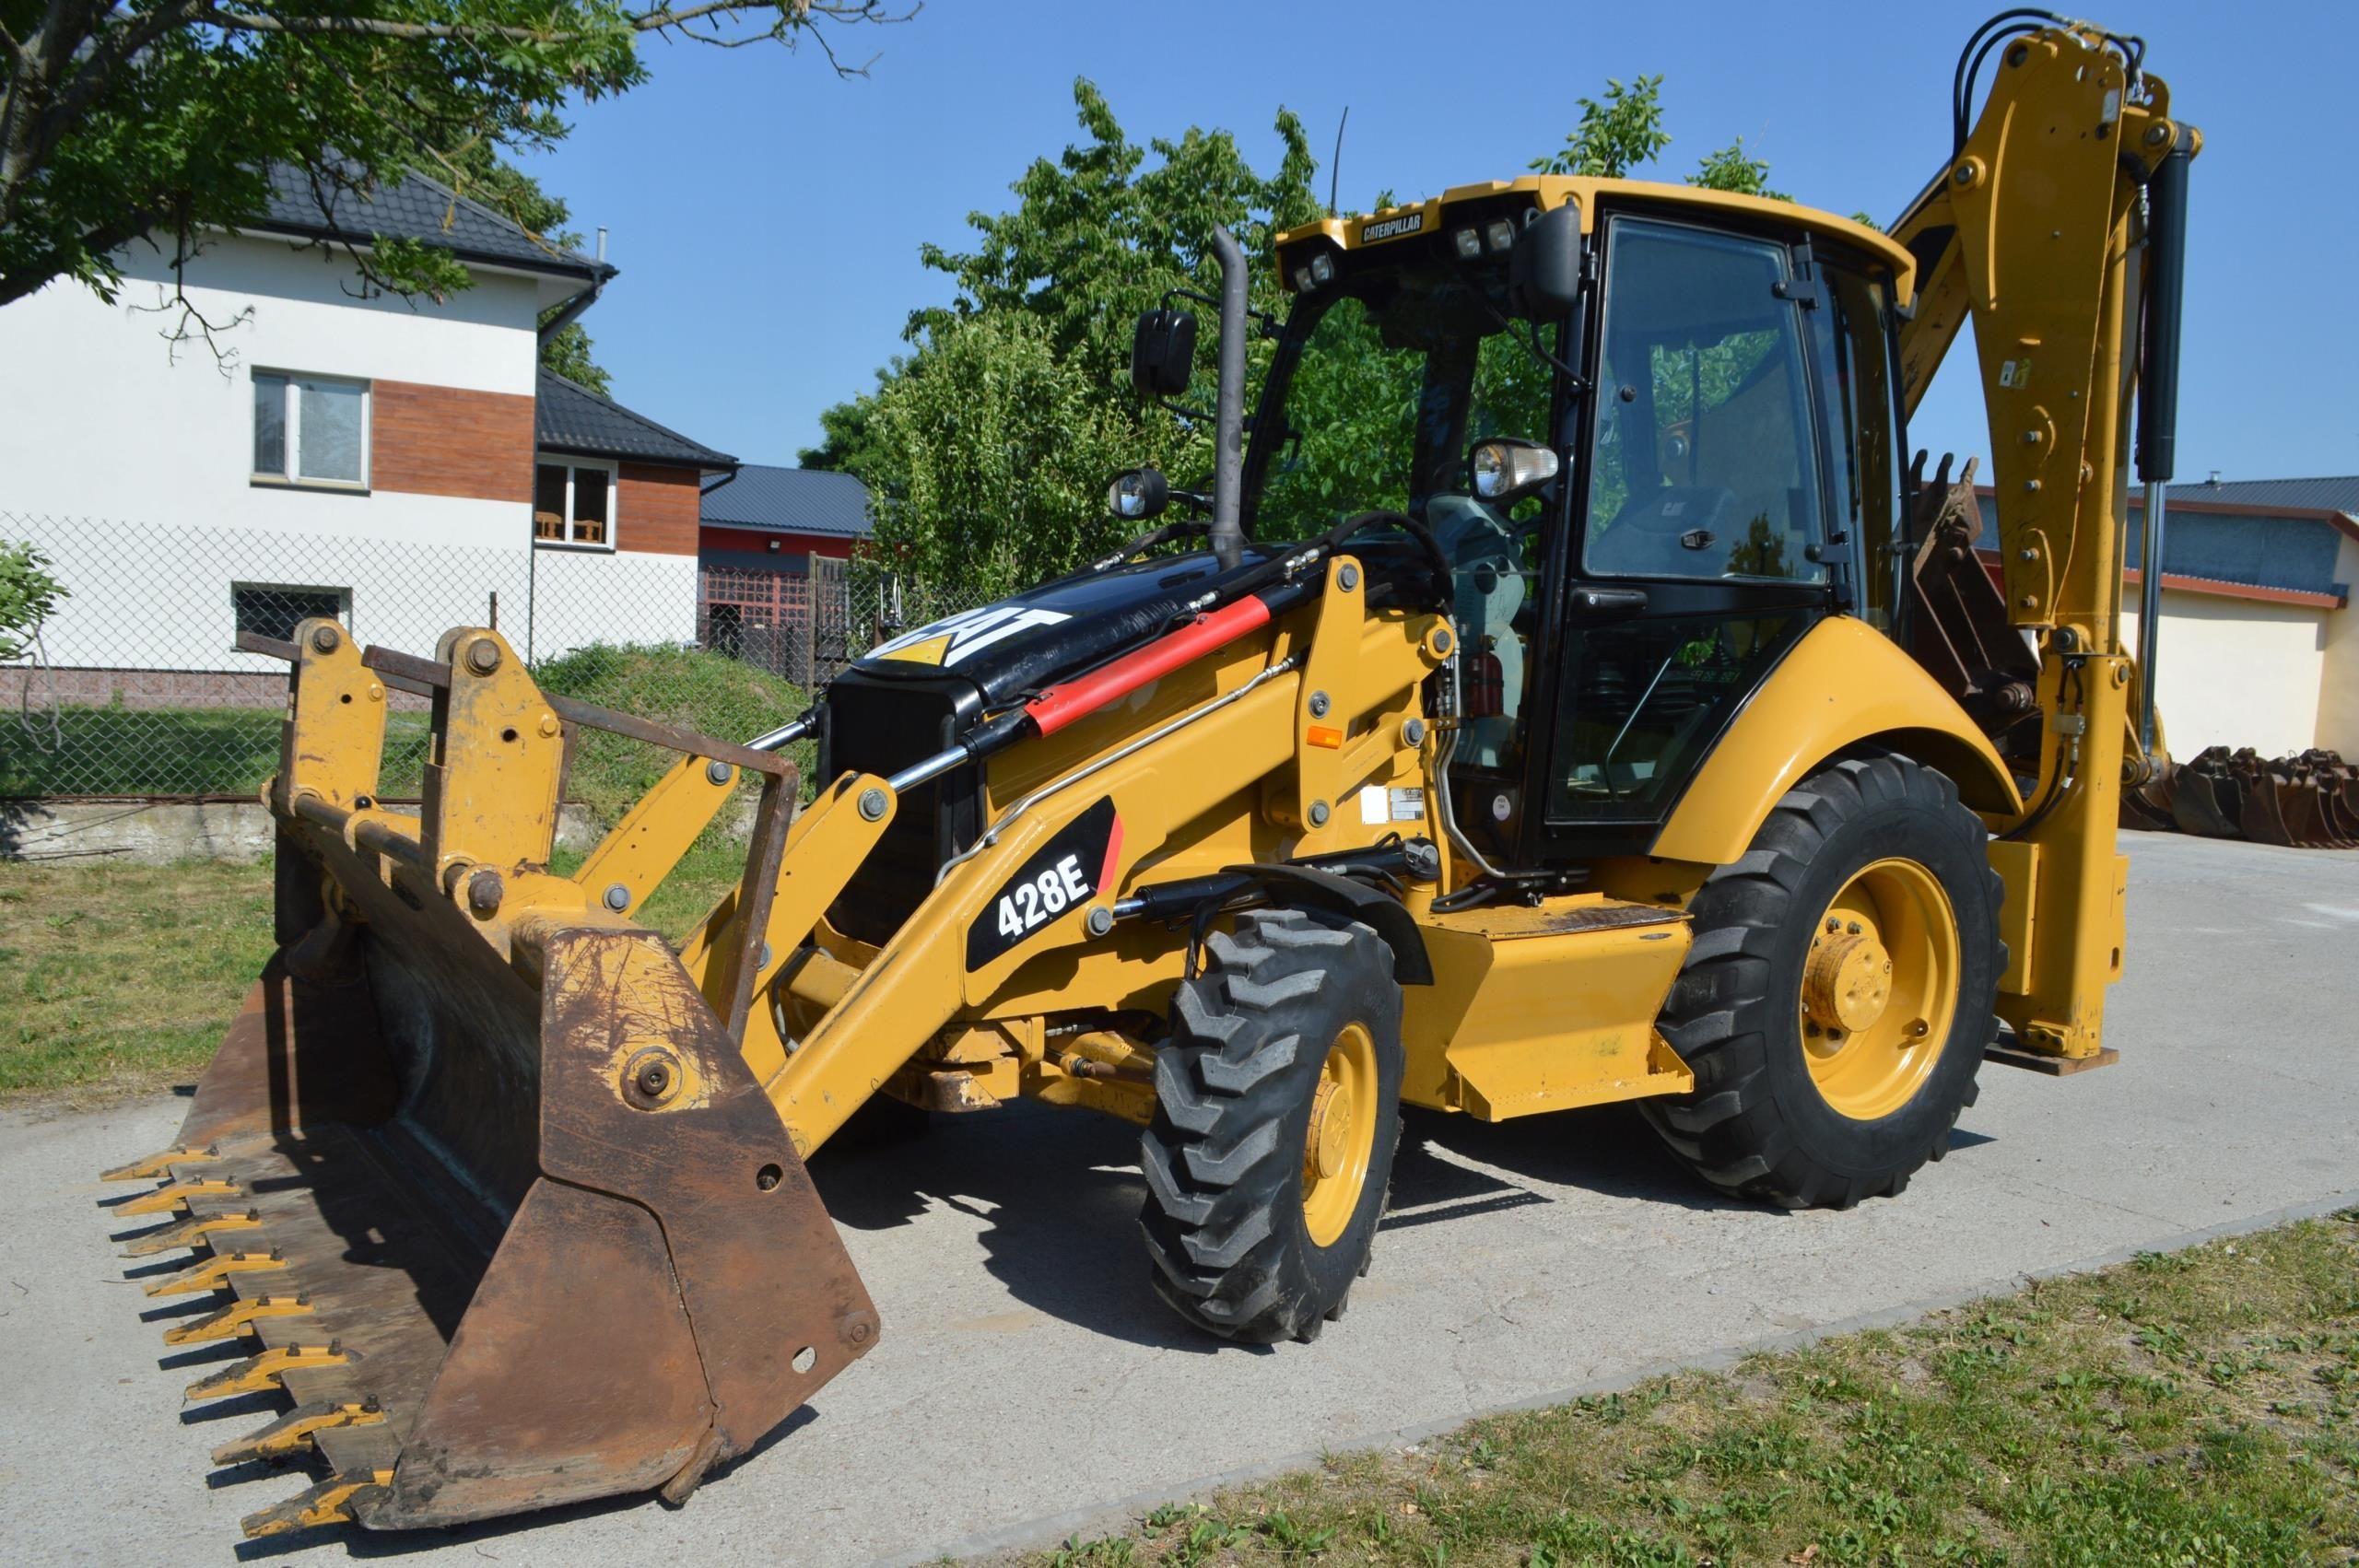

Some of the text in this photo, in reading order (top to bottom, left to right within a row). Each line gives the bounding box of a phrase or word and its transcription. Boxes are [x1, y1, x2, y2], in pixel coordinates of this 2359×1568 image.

[1364, 215, 1421, 241] CATERPILLAR
[863, 607, 1074, 668] CAT
[998, 854, 1089, 936] 428E
